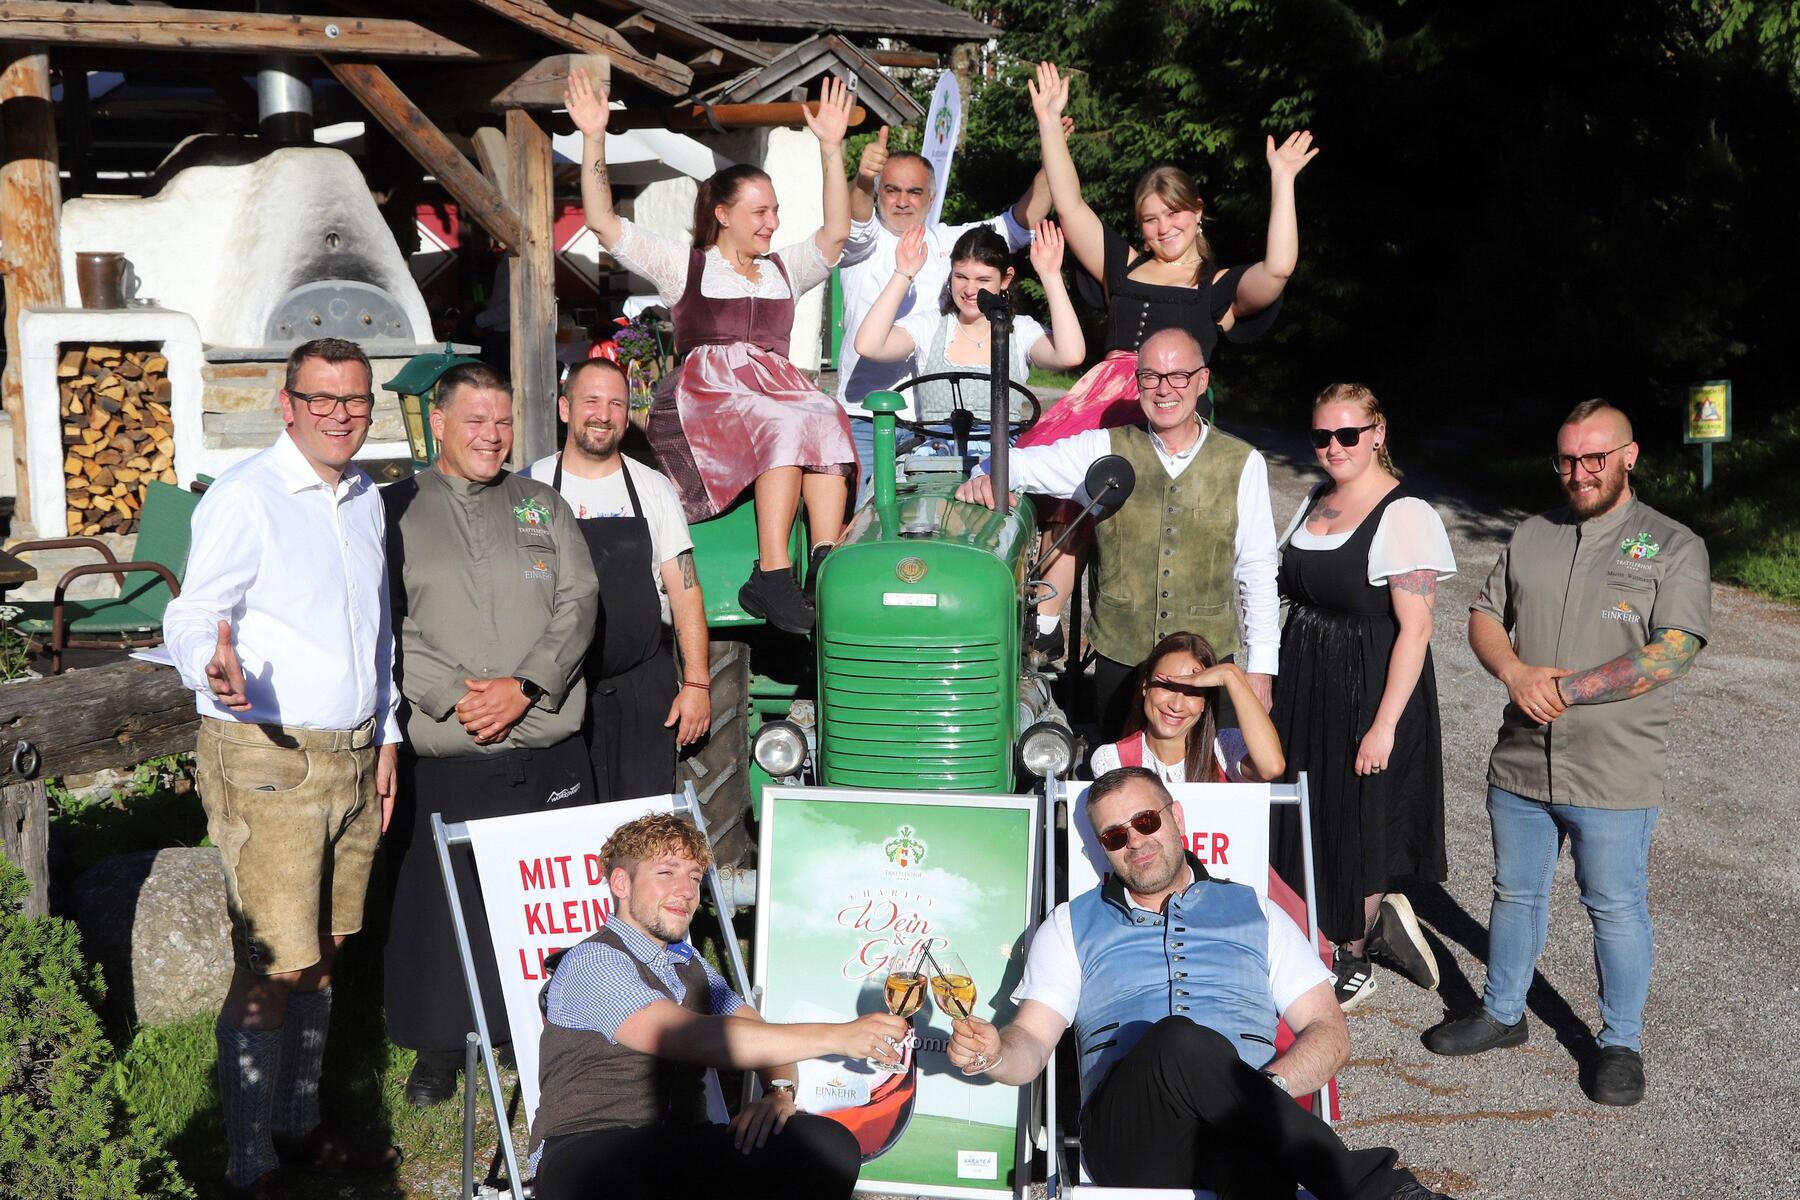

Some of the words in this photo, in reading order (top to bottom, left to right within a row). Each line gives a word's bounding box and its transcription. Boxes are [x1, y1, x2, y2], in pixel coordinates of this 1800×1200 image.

[1601, 609, 1641, 623] EINKEHR
[518, 855, 572, 891] MIT
[837, 897, 934, 935] Wein
[893, 932, 907, 946] &
[815, 1086, 857, 1101] EINKEHR
